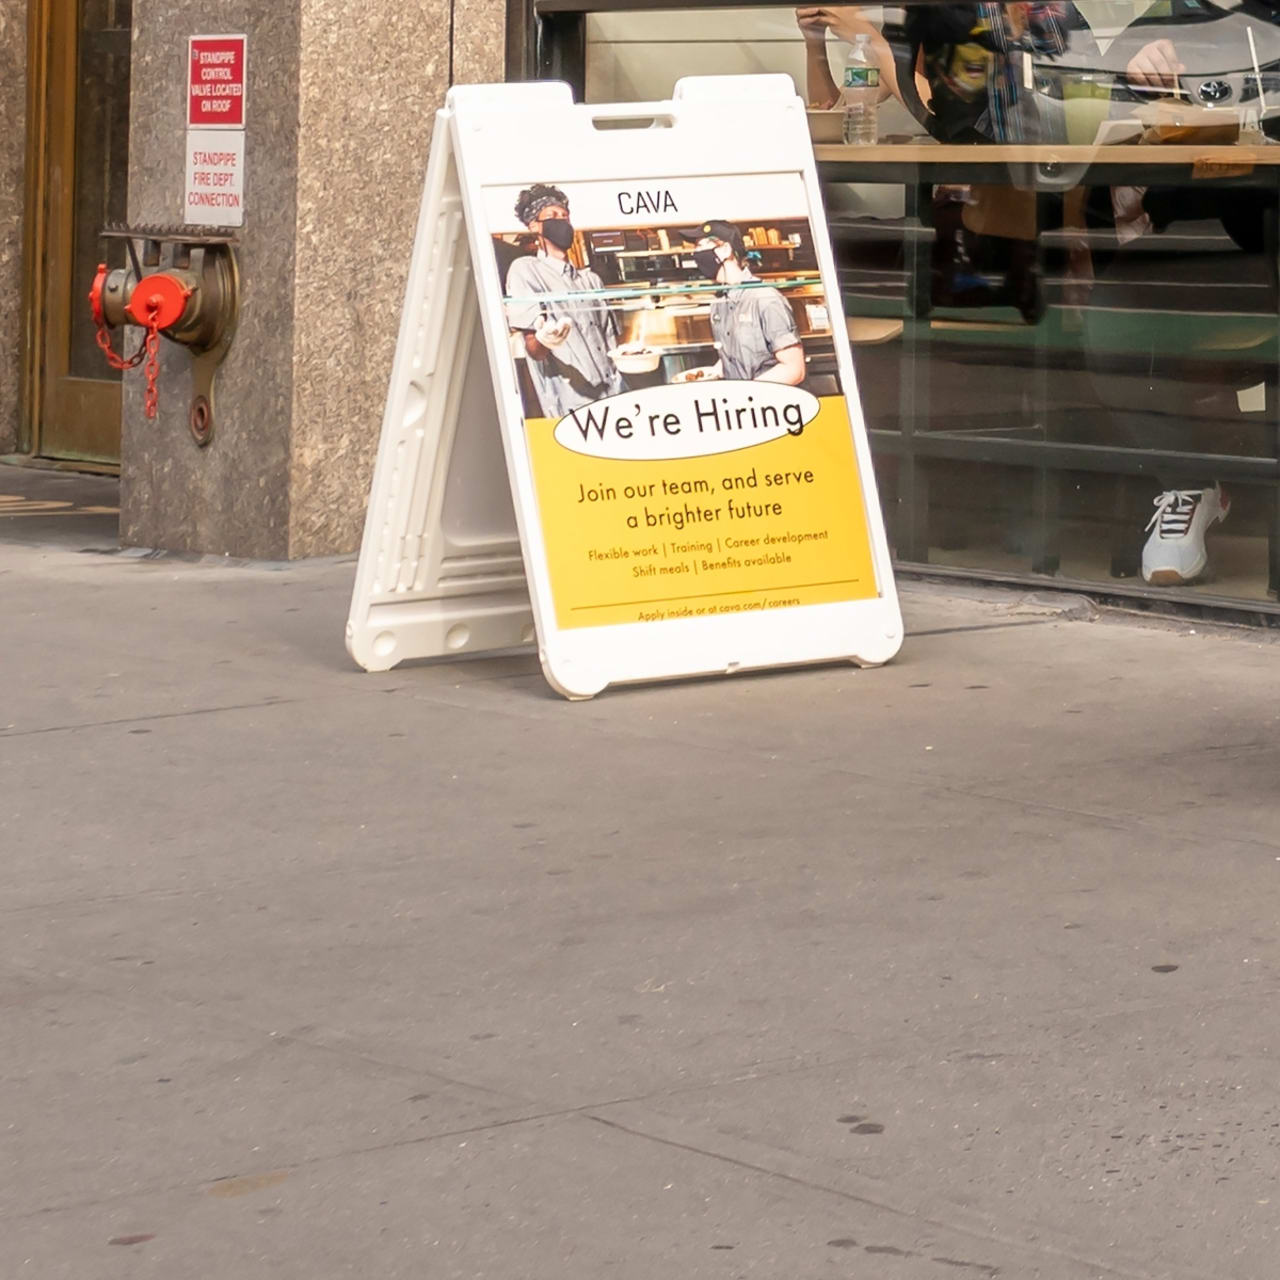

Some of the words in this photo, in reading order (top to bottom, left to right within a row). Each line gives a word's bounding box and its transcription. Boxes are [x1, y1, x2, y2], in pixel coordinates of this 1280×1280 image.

[200, 51, 235, 64] STANDPIPE
[201, 68, 232, 80] CONTROL
[191, 84, 211, 96] VALVE
[212, 84, 242, 96] LOCATED
[201, 100, 211, 111] ON
[212, 100, 231, 112] ROOF
[193, 152, 236, 167] STANDPIPE
[193, 172, 211, 186] FIRE
[188, 192, 239, 207] CONNECTION
[617, 190, 678, 215] CAVA
[694, 396, 804, 436] Hiring
[577, 482, 617, 503] Join
[623, 484, 655, 499] our
[662, 479, 715, 496] team,
[721, 468, 757, 490] and
[765, 469, 814, 487] serve
[626, 515, 638, 529] a
[644, 503, 722, 530] brighter
[727, 499, 783, 520] future
[588, 548, 629, 561] Flexible
[633, 545, 658, 558] work
[671, 541, 713, 554] Training
[725, 536, 760, 549] Career
[763, 530, 828, 546] development
[632, 564, 656, 578] Shift
[660, 562, 690, 575] meals
[702, 558, 741, 571] Benefits
[744, 553, 791, 567] available
[638, 610, 664, 622] Apply
[667, 607, 693, 618] inside
[696, 607, 705, 615] or
[708, 605, 717, 614] at
